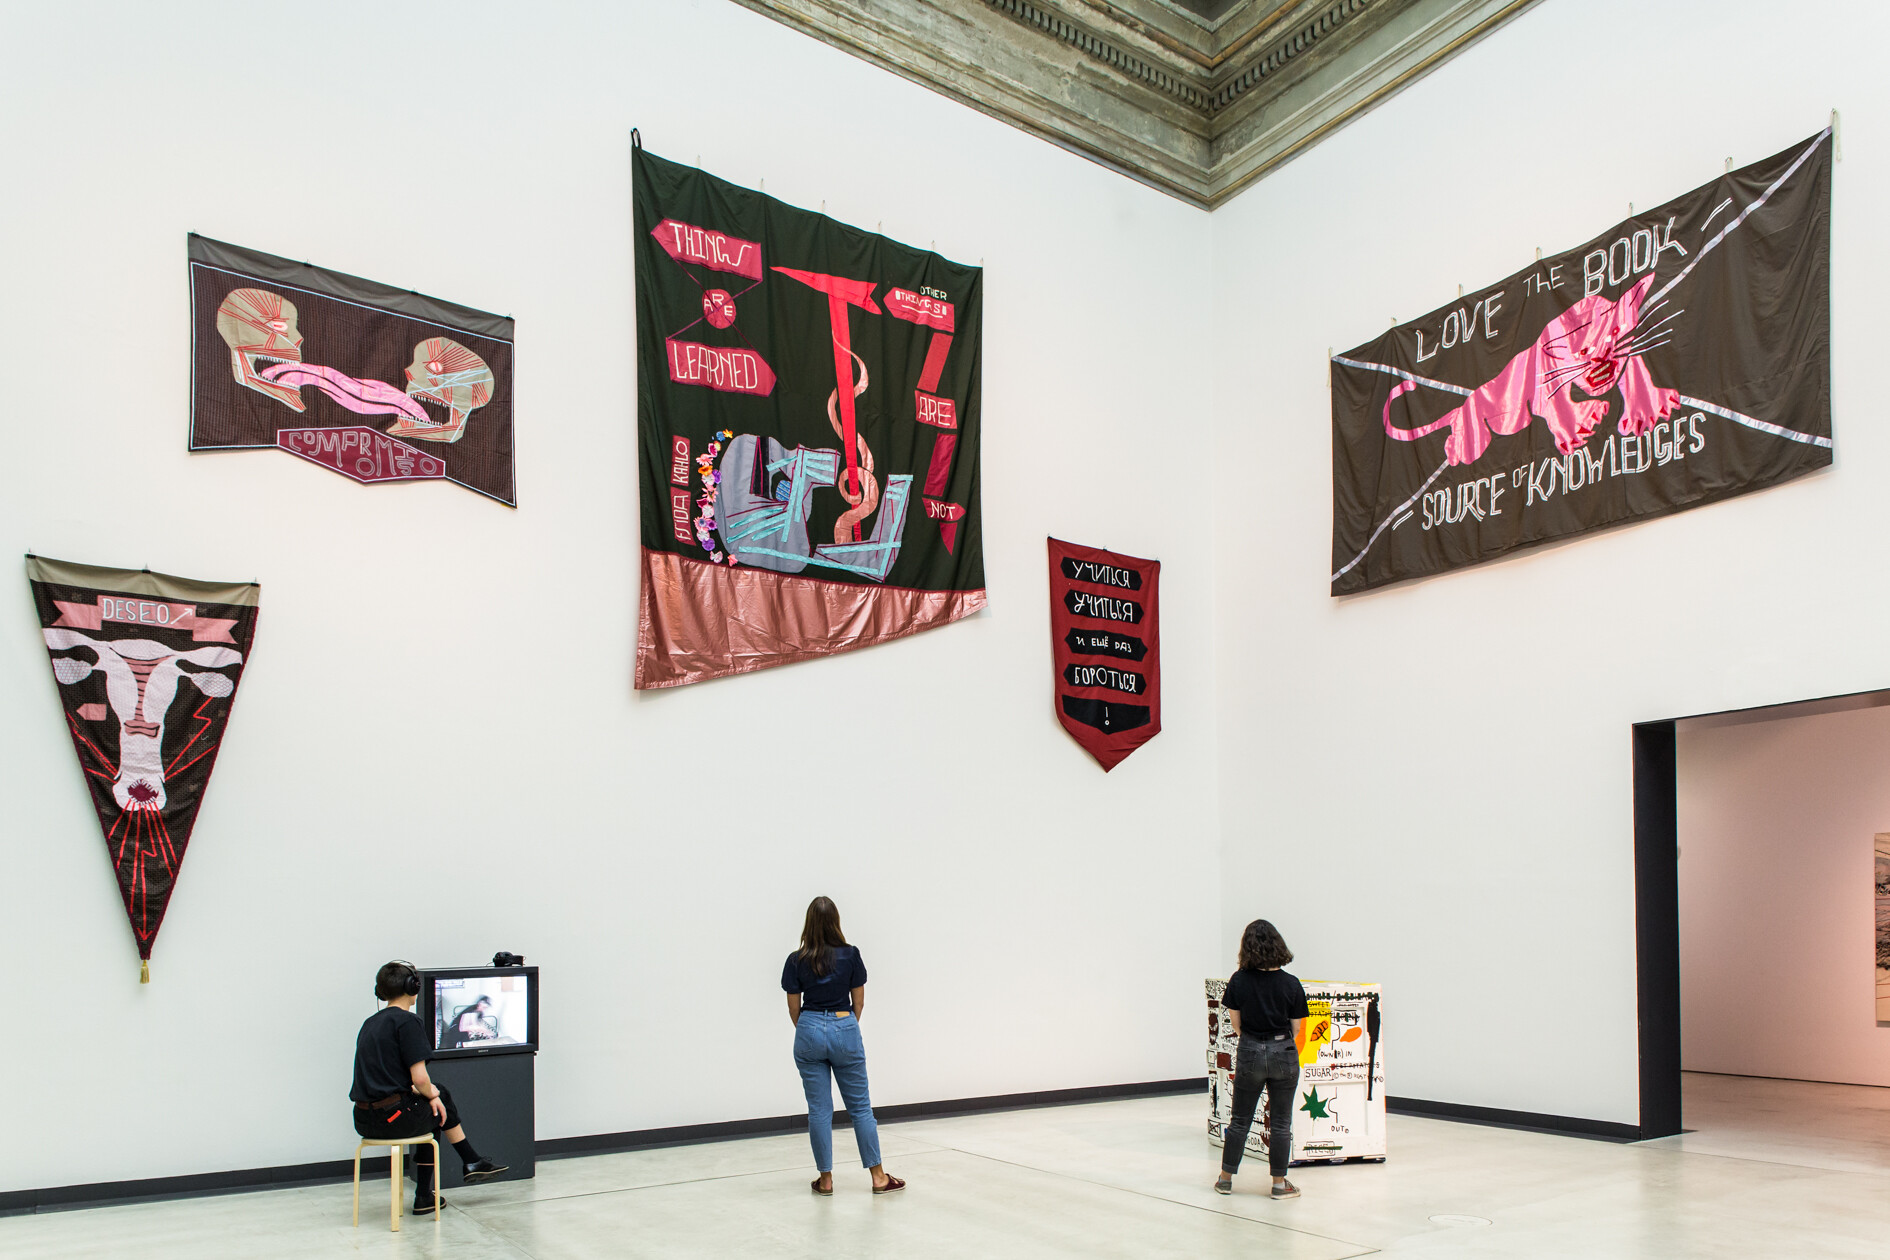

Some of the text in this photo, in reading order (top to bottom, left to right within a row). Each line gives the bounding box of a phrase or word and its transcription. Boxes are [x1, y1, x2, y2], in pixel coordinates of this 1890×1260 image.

[668, 222, 753, 267] THINGS
[919, 285, 948, 301] OTHER
[1415, 291, 1505, 363] LOVE
[1583, 216, 1688, 298] BOOK
[703, 293, 734, 317] ARE
[674, 343, 759, 389] LEARNED
[918, 396, 952, 426] ARE
[672, 440, 689, 484] KAHLO
[1421, 412, 1707, 531] SOURCE OF KNOWLEDGES
[930, 501, 956, 519] NOT
[1071, 560, 1131, 589] УЧИТЬСЯ
[102, 597, 170, 625] DESEO
[1073, 591, 1133, 622] УЧИТЬСЯ
[1114, 641, 1132, 653] РАЗ
[1074, 667, 1137, 693] БОРОТЬСЯ
[1305, 1067, 1332, 1078] SUGAR
